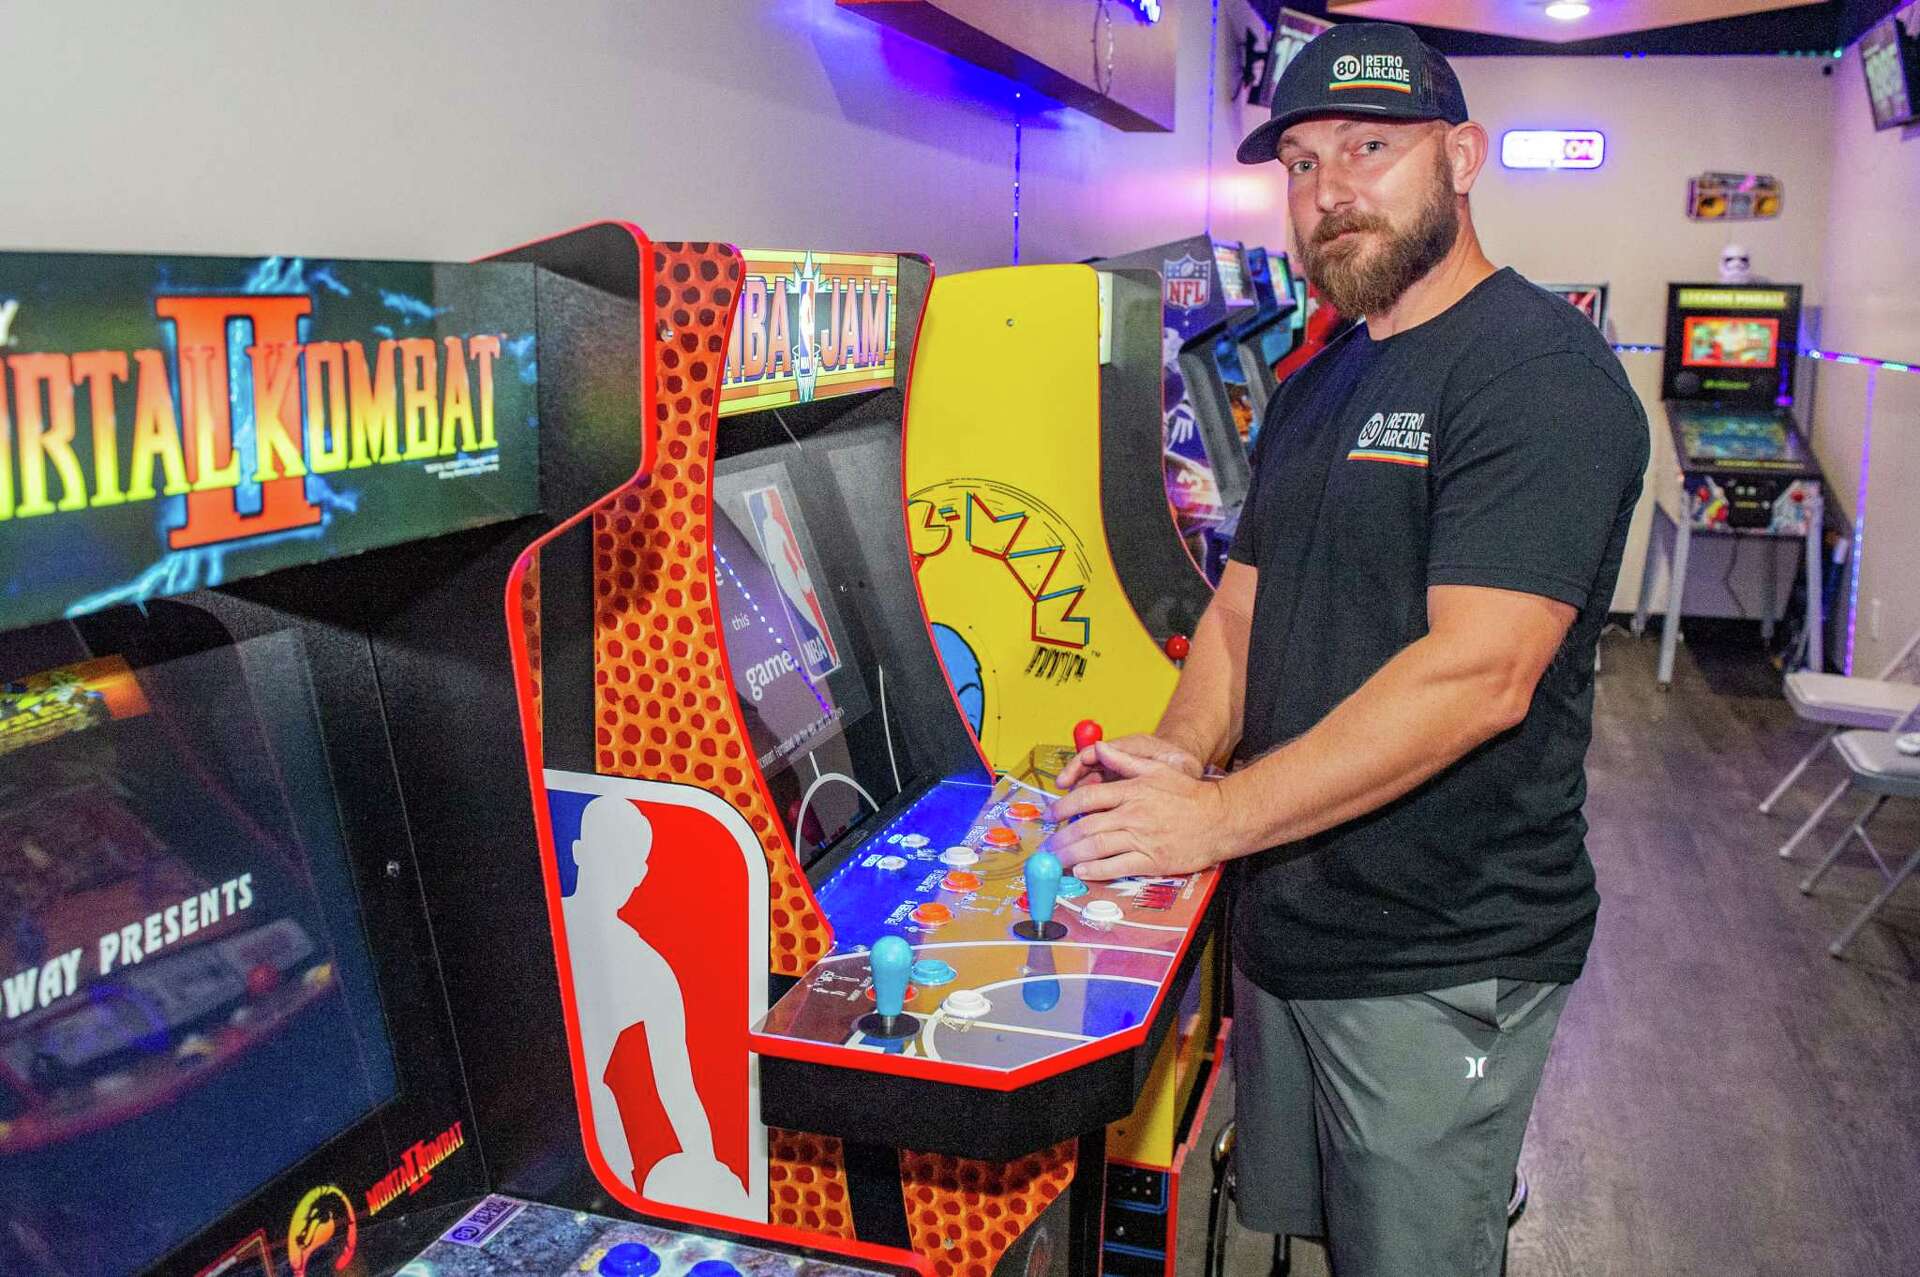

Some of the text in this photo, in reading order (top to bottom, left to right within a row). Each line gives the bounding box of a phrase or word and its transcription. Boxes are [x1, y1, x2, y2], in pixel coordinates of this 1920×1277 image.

[1335, 59, 1358, 77] 80
[1365, 54, 1403, 68] RETRO
[1365, 66, 1410, 82] ARCADE
[1168, 280, 1205, 305] NFL
[820, 277, 890, 371] JAM
[246, 336, 499, 482] KOMBAT
[1360, 419, 1382, 441] 80
[1387, 412, 1425, 430] RETRO
[1380, 429, 1431, 451] ARCADE
[731, 613, 750, 631] this
[803, 638, 828, 667] NBA
[0, 872, 253, 1018] WAY PRESENTS
